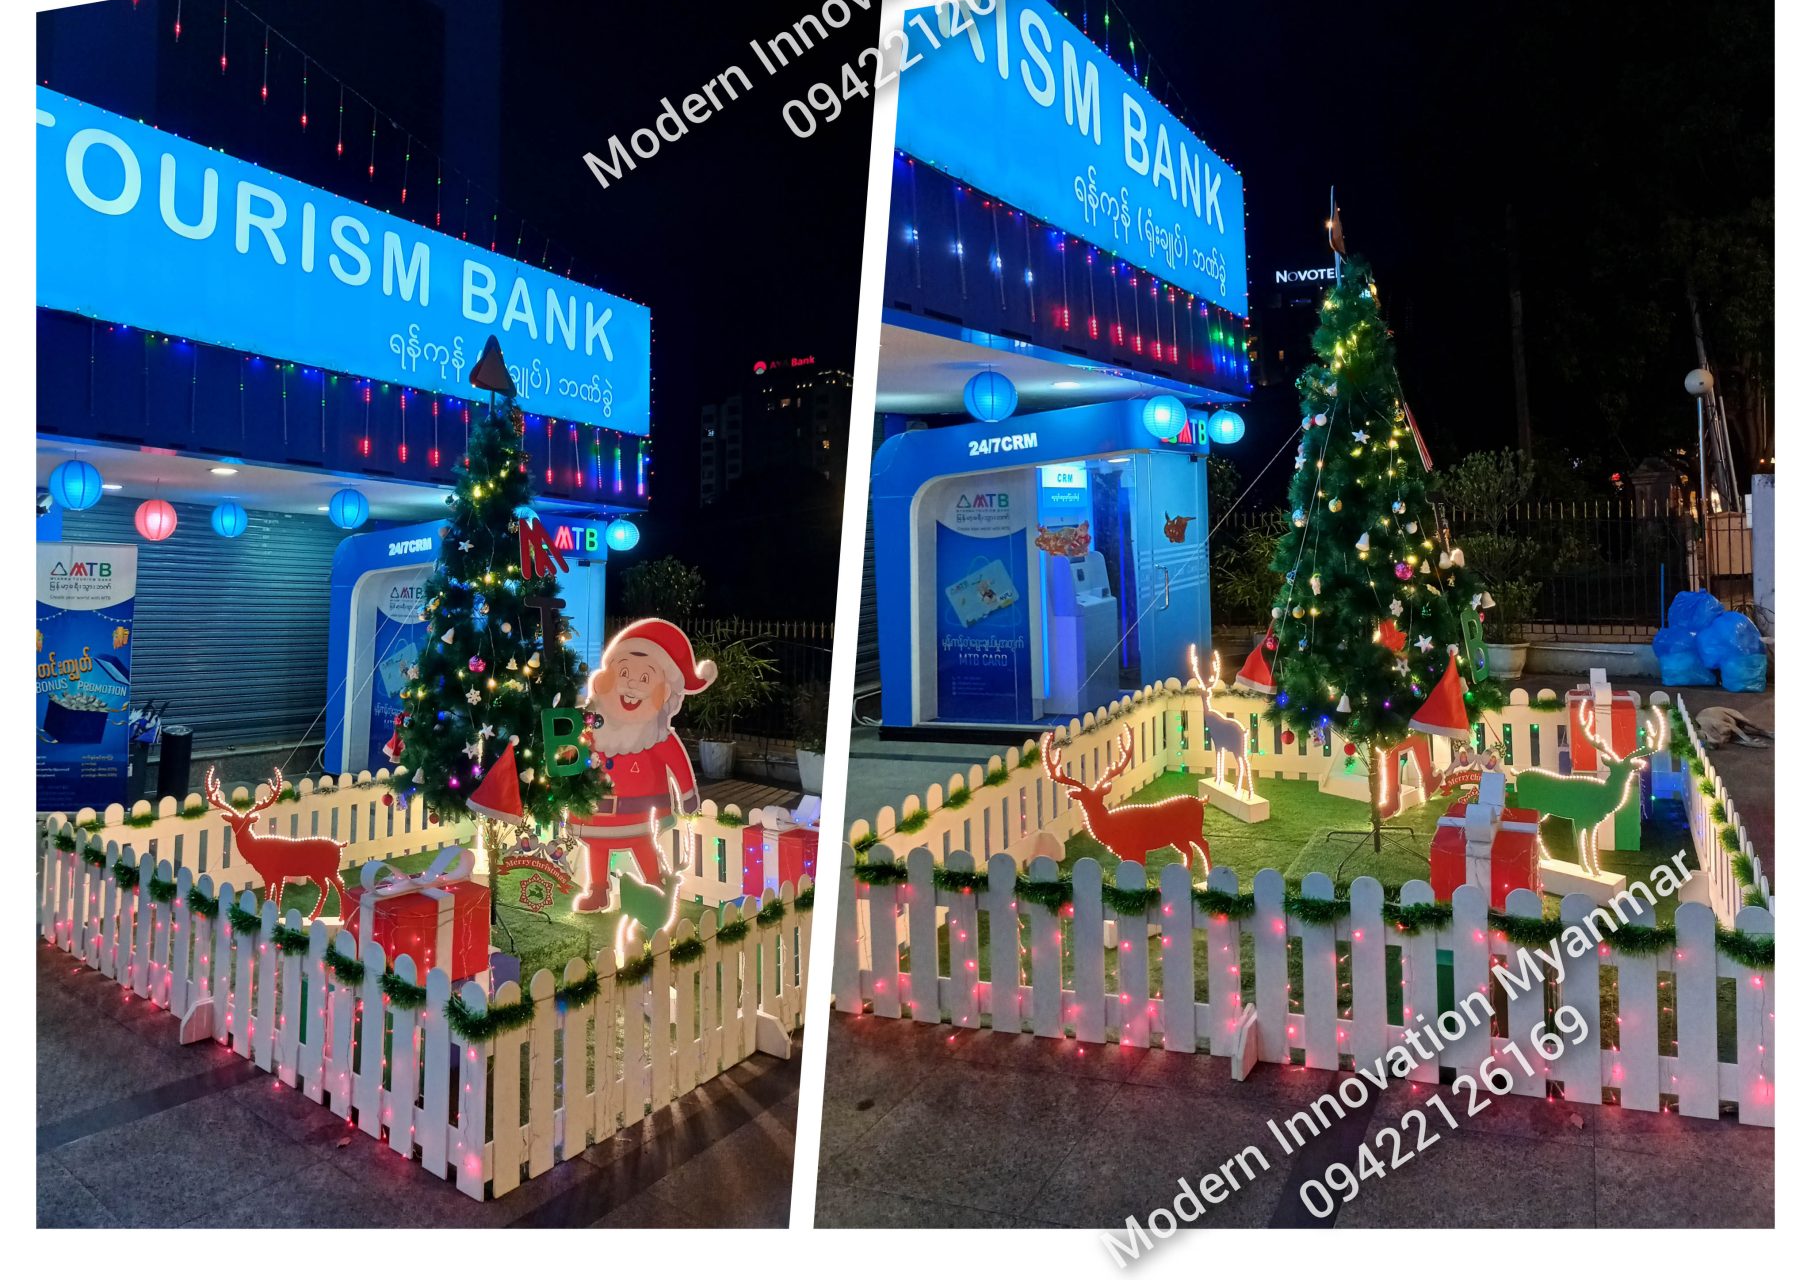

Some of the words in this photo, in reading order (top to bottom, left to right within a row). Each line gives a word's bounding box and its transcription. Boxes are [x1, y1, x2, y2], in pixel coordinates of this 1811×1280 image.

[1123, 92, 1224, 234] BANK
[1075, 165, 1130, 244] ရန်ကုန်
[36, 108, 431, 308] OURISM
[462, 259, 615, 362] BANK
[389, 323, 466, 383] ရန်ကုန်
[791, 355, 815, 367] Bank
[968, 433, 1038, 456] 24/7CRM
[973, 493, 1009, 508] MTB
[389, 537, 432, 556] 24/7CRM
[554, 525, 598, 551] MTB
[69, 562, 112, 577] MTB
[959, 653, 979, 666] MTB
[982, 653, 1008, 666] CARD
[77, 681, 127, 697] PROMOTION
[541, 706, 590, 778] B
[1448, 774, 1469, 787] Merry
[506, 859, 532, 868] Merry
